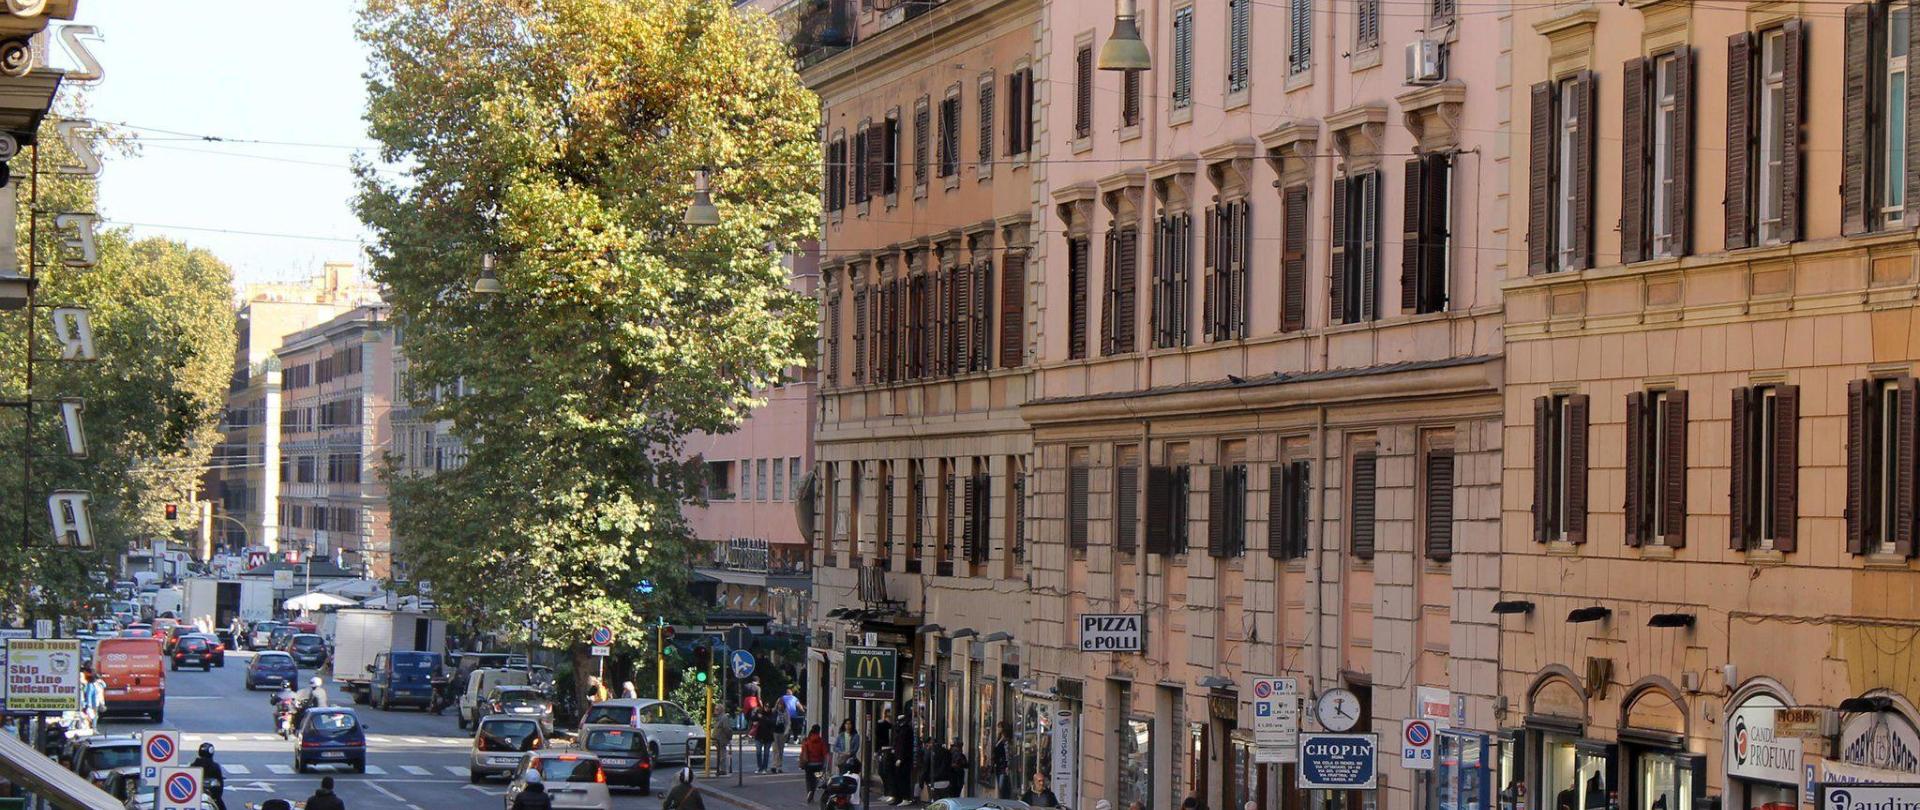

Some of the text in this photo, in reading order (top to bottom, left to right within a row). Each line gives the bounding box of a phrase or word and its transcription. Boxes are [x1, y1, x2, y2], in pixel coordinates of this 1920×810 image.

[1085, 617, 1137, 631] PIZZA
[47, 642, 77, 650] TOURS
[1084, 636, 1137, 649] e POLLI
[10, 664, 39, 675] Skip
[10, 675, 62, 684] the Line
[10, 684, 76, 694] Vatican Tour
[1777, 709, 1816, 723] HOBBY
[1306, 744, 1371, 756] CHOPIN
[1892, 730, 1918, 774] SPORT
[1750, 744, 1796, 771] PROFUMI
